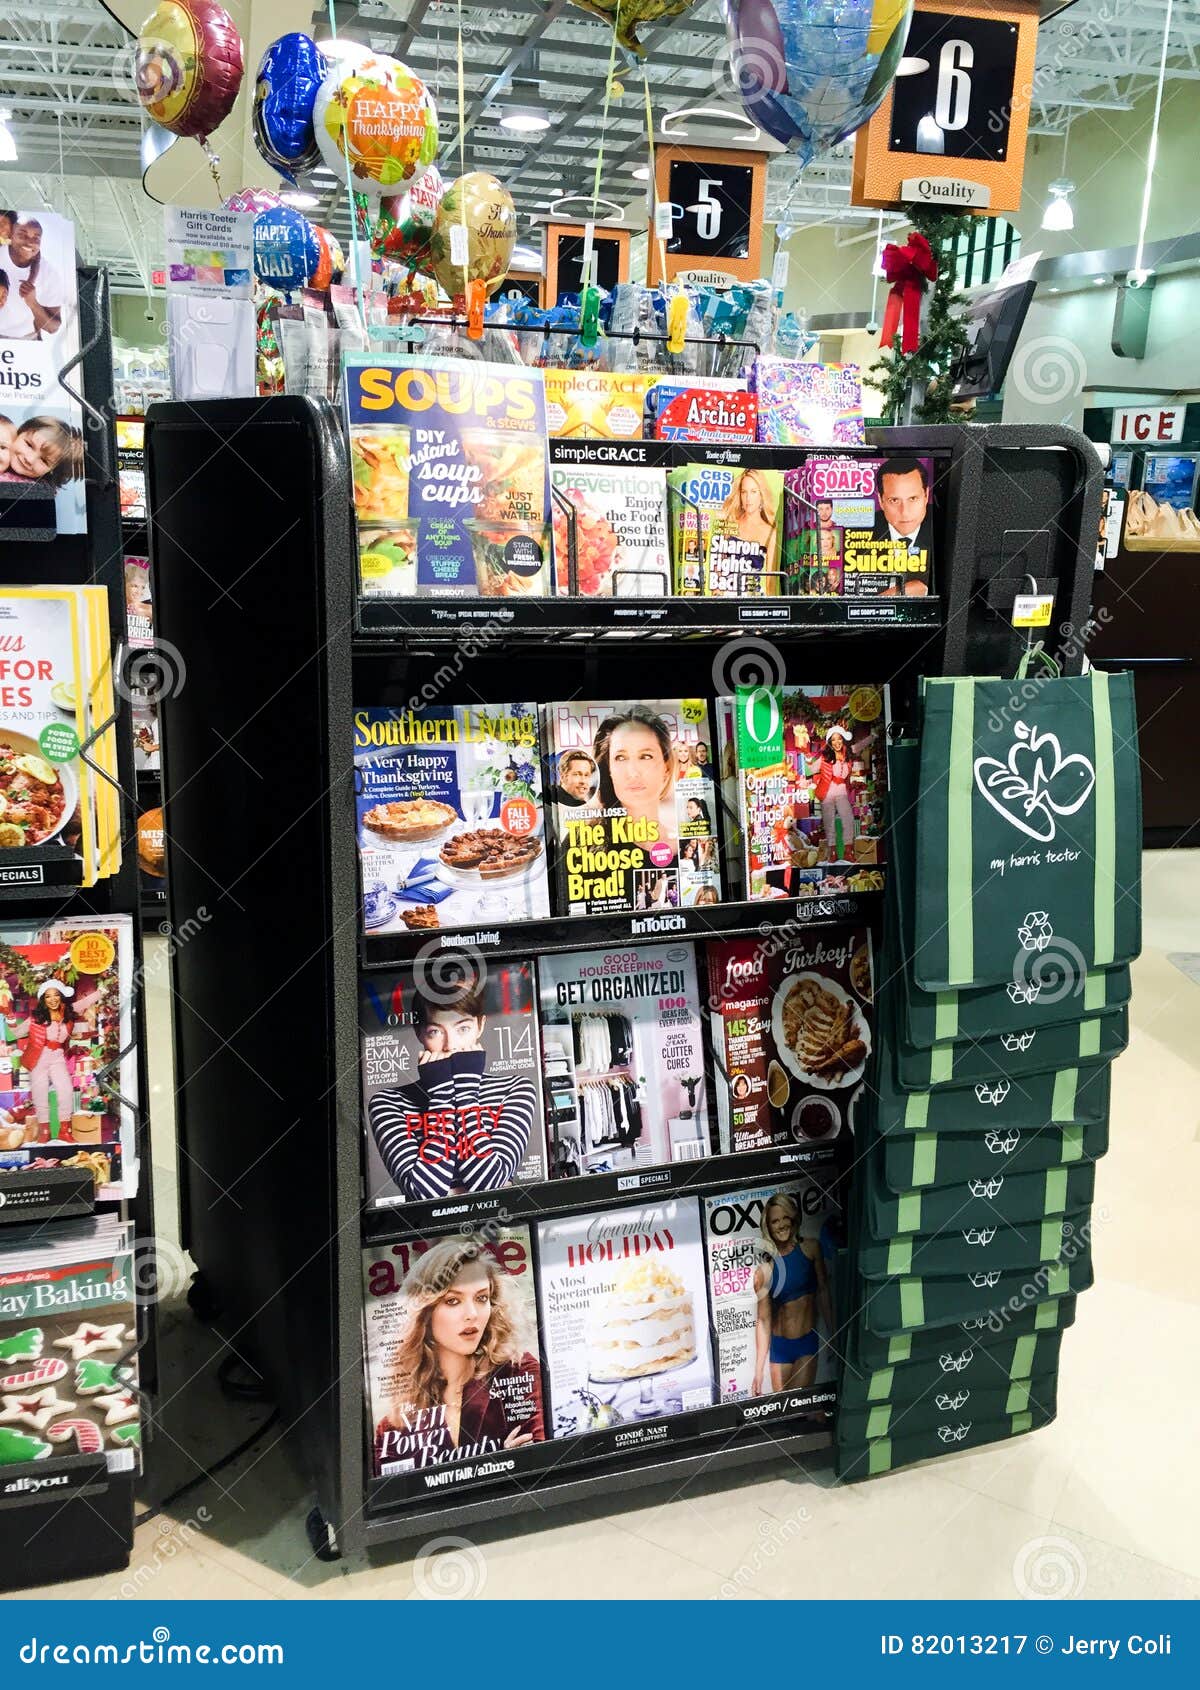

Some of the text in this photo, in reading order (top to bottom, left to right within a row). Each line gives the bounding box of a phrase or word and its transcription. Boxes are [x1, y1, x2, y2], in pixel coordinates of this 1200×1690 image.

[936, 39, 975, 131] 6
[356, 100, 422, 121] HAPPY
[352, 119, 427, 142] Thanksgiving
[917, 180, 976, 203] Quality
[180, 209, 237, 224] Harris Teeter
[696, 179, 723, 241] 5
[186, 221, 232, 234] Gift Cards
[686, 271, 728, 287] Quality
[359, 368, 536, 420] SOUPS
[687, 398, 747, 428] Archie
[486, 418, 536, 432] & stews
[1120, 411, 1176, 441] ICE
[416, 429, 445, 444] DIY
[554, 445, 648, 463] simpleGRACE
[829, 462, 857, 470] ABC
[418, 462, 484, 487] soup
[700, 470, 732, 481] CBS
[552, 470, 667, 496] Prevention
[814, 469, 876, 498] SOAPS
[421, 484, 485, 508] cups
[505, 491, 533, 502] JUST
[625, 496, 663, 510] Enjoy
[509, 501, 532, 512] ADD
[500, 510, 541, 522] WATER!
[606, 511, 662, 523] the Food
[610, 524, 665, 536] Lose the
[844, 530, 874, 541] Sonny
[616, 536, 666, 548] Pounds
[844, 539, 907, 550] Contemplates
[656, 554, 665, 567] 6
[710, 553, 753, 576] Fights
[844, 550, 929, 573] Suicide!
[11, 711, 58, 720] AND TIPS
[682, 707, 703, 720] $2.99
[745, 687, 781, 744] O
[354, 709, 538, 748] Southern Living
[363, 754, 450, 771] A Very Happy
[363, 768, 454, 785] Thanksgiving
[746, 774, 789, 791] Oprah's
[755, 789, 811, 808] Favorite
[507, 807, 531, 819] FALL
[564, 807, 629, 820] ANGELINA LOSES
[748, 808, 786, 825] Things!
[508, 818, 531, 831] PIES
[565, 820, 606, 848] The
[612, 815, 661, 847] Kids
[566, 846, 645, 875] Choose
[990, 848, 1082, 877] my harris teeter
[568, 871, 626, 902] Brad!
[631, 914, 688, 934] InTouch
[86, 940, 99, 949] 10
[441, 931, 501, 947] Southern Living
[79, 950, 107, 958] BEST
[603, 952, 639, 965] GOOD
[782, 936, 856, 974] Turkey!
[579, 960, 664, 977] HOUSEKEEPING
[726, 954, 765, 986] food
[557, 970, 686, 1006] GET ORGANIZED!
[658, 997, 687, 1011] 100
[725, 996, 770, 1011] magazine
[661, 1008, 690, 1019] IDEAS FOR
[659, 1019, 676, 1029] EVERY
[727, 1016, 772, 1037] 145 Easy
[493, 1023, 535, 1061] 114
[666, 1033, 687, 1041] QUICK
[672, 1038, 689, 1047] EASY
[365, 1045, 410, 1061] EMMA
[662, 1045, 694, 1059] CLUTTER
[728, 1042, 748, 1052] RECIPES
[366, 1057, 411, 1075] STONE
[666, 1056, 691, 1070] CURES
[405, 1104, 504, 1139] PRETTY
[733, 1113, 744, 1125] 50
[734, 1129, 764, 1142] Ultimate
[419, 1132, 494, 1164] CHIC
[735, 1137, 772, 1152] BREAD-BOWL
[618, 1174, 670, 1188] SPC SPECIALS
[431, 1200, 500, 1217] GLAMOUR VOGUE
[587, 1212, 657, 1253] Gourmet
[568, 1229, 674, 1268] HOLIDAY
[711, 1245, 755, 1262] SCULPT
[713, 1252, 772, 1273] A STRONG
[549, 1276, 587, 1290] A Most
[713, 1267, 751, 1284] UPPER
[33, 1274, 128, 1310] Baking
[548, 1282, 618, 1304] Spectacular
[714, 1280, 748, 1296] BODY
[549, 1299, 591, 1315] Season
[716, 1307, 735, 1316] BUILD
[717, 1319, 740, 1329] POWER
[717, 1321, 757, 1335] ENDURANCE
[731, 1344, 747, 1352] Right
[731, 1357, 747, 1366] Right
[721, 1366, 735, 1374] Time
[492, 1372, 535, 1389] Amanda
[728, 1379, 737, 1393] 5
[489, 1383, 533, 1400] Seyfried
[504, 1401, 536, 1409] Absolutely,
[743, 1393, 837, 1418] oxygen Clean Eating
[516, 1412, 531, 1421] Filter
[615, 1425, 668, 1442] CONDÉ NAST
[615, 1433, 668, 1447] SPECIAL EDITIONS
[379, 1427, 451, 1459] Power
[421, 1436, 503, 1467] Beauty
[424, 1472, 455, 1488] VANITY
